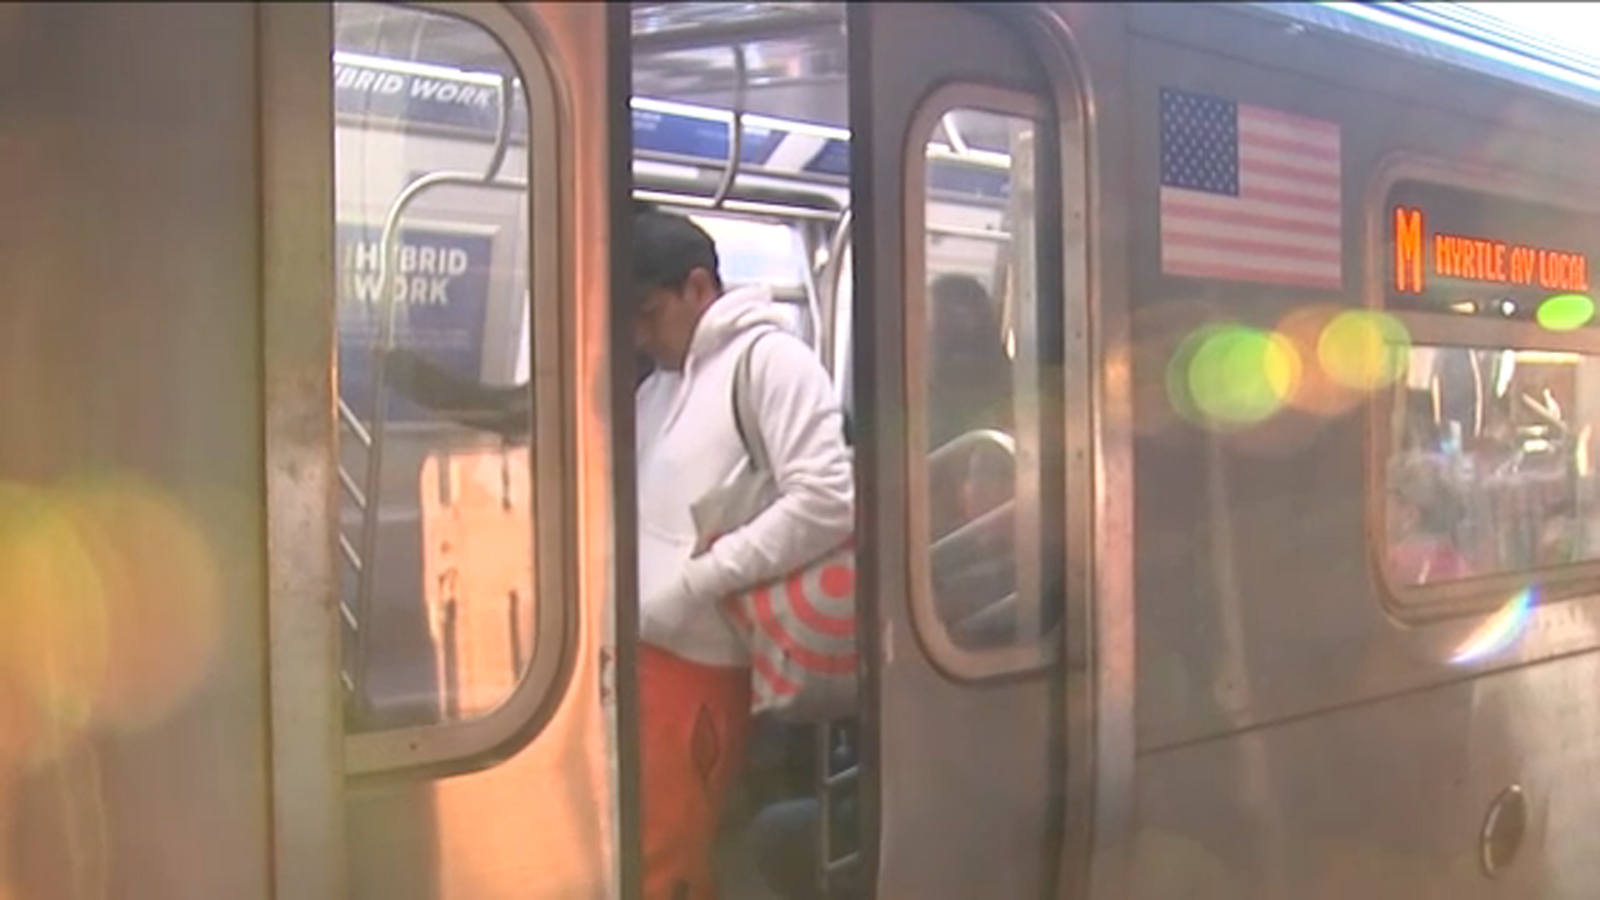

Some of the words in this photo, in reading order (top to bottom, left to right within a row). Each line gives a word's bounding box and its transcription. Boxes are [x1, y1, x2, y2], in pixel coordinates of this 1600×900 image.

[335, 65, 404, 94] BRID
[411, 77, 496, 107] WORK
[1395, 207, 1421, 293] M
[1435, 234, 1507, 281] MYRTLE
[1510, 246, 1536, 285] AV
[1539, 250, 1590, 292] LOCAL
